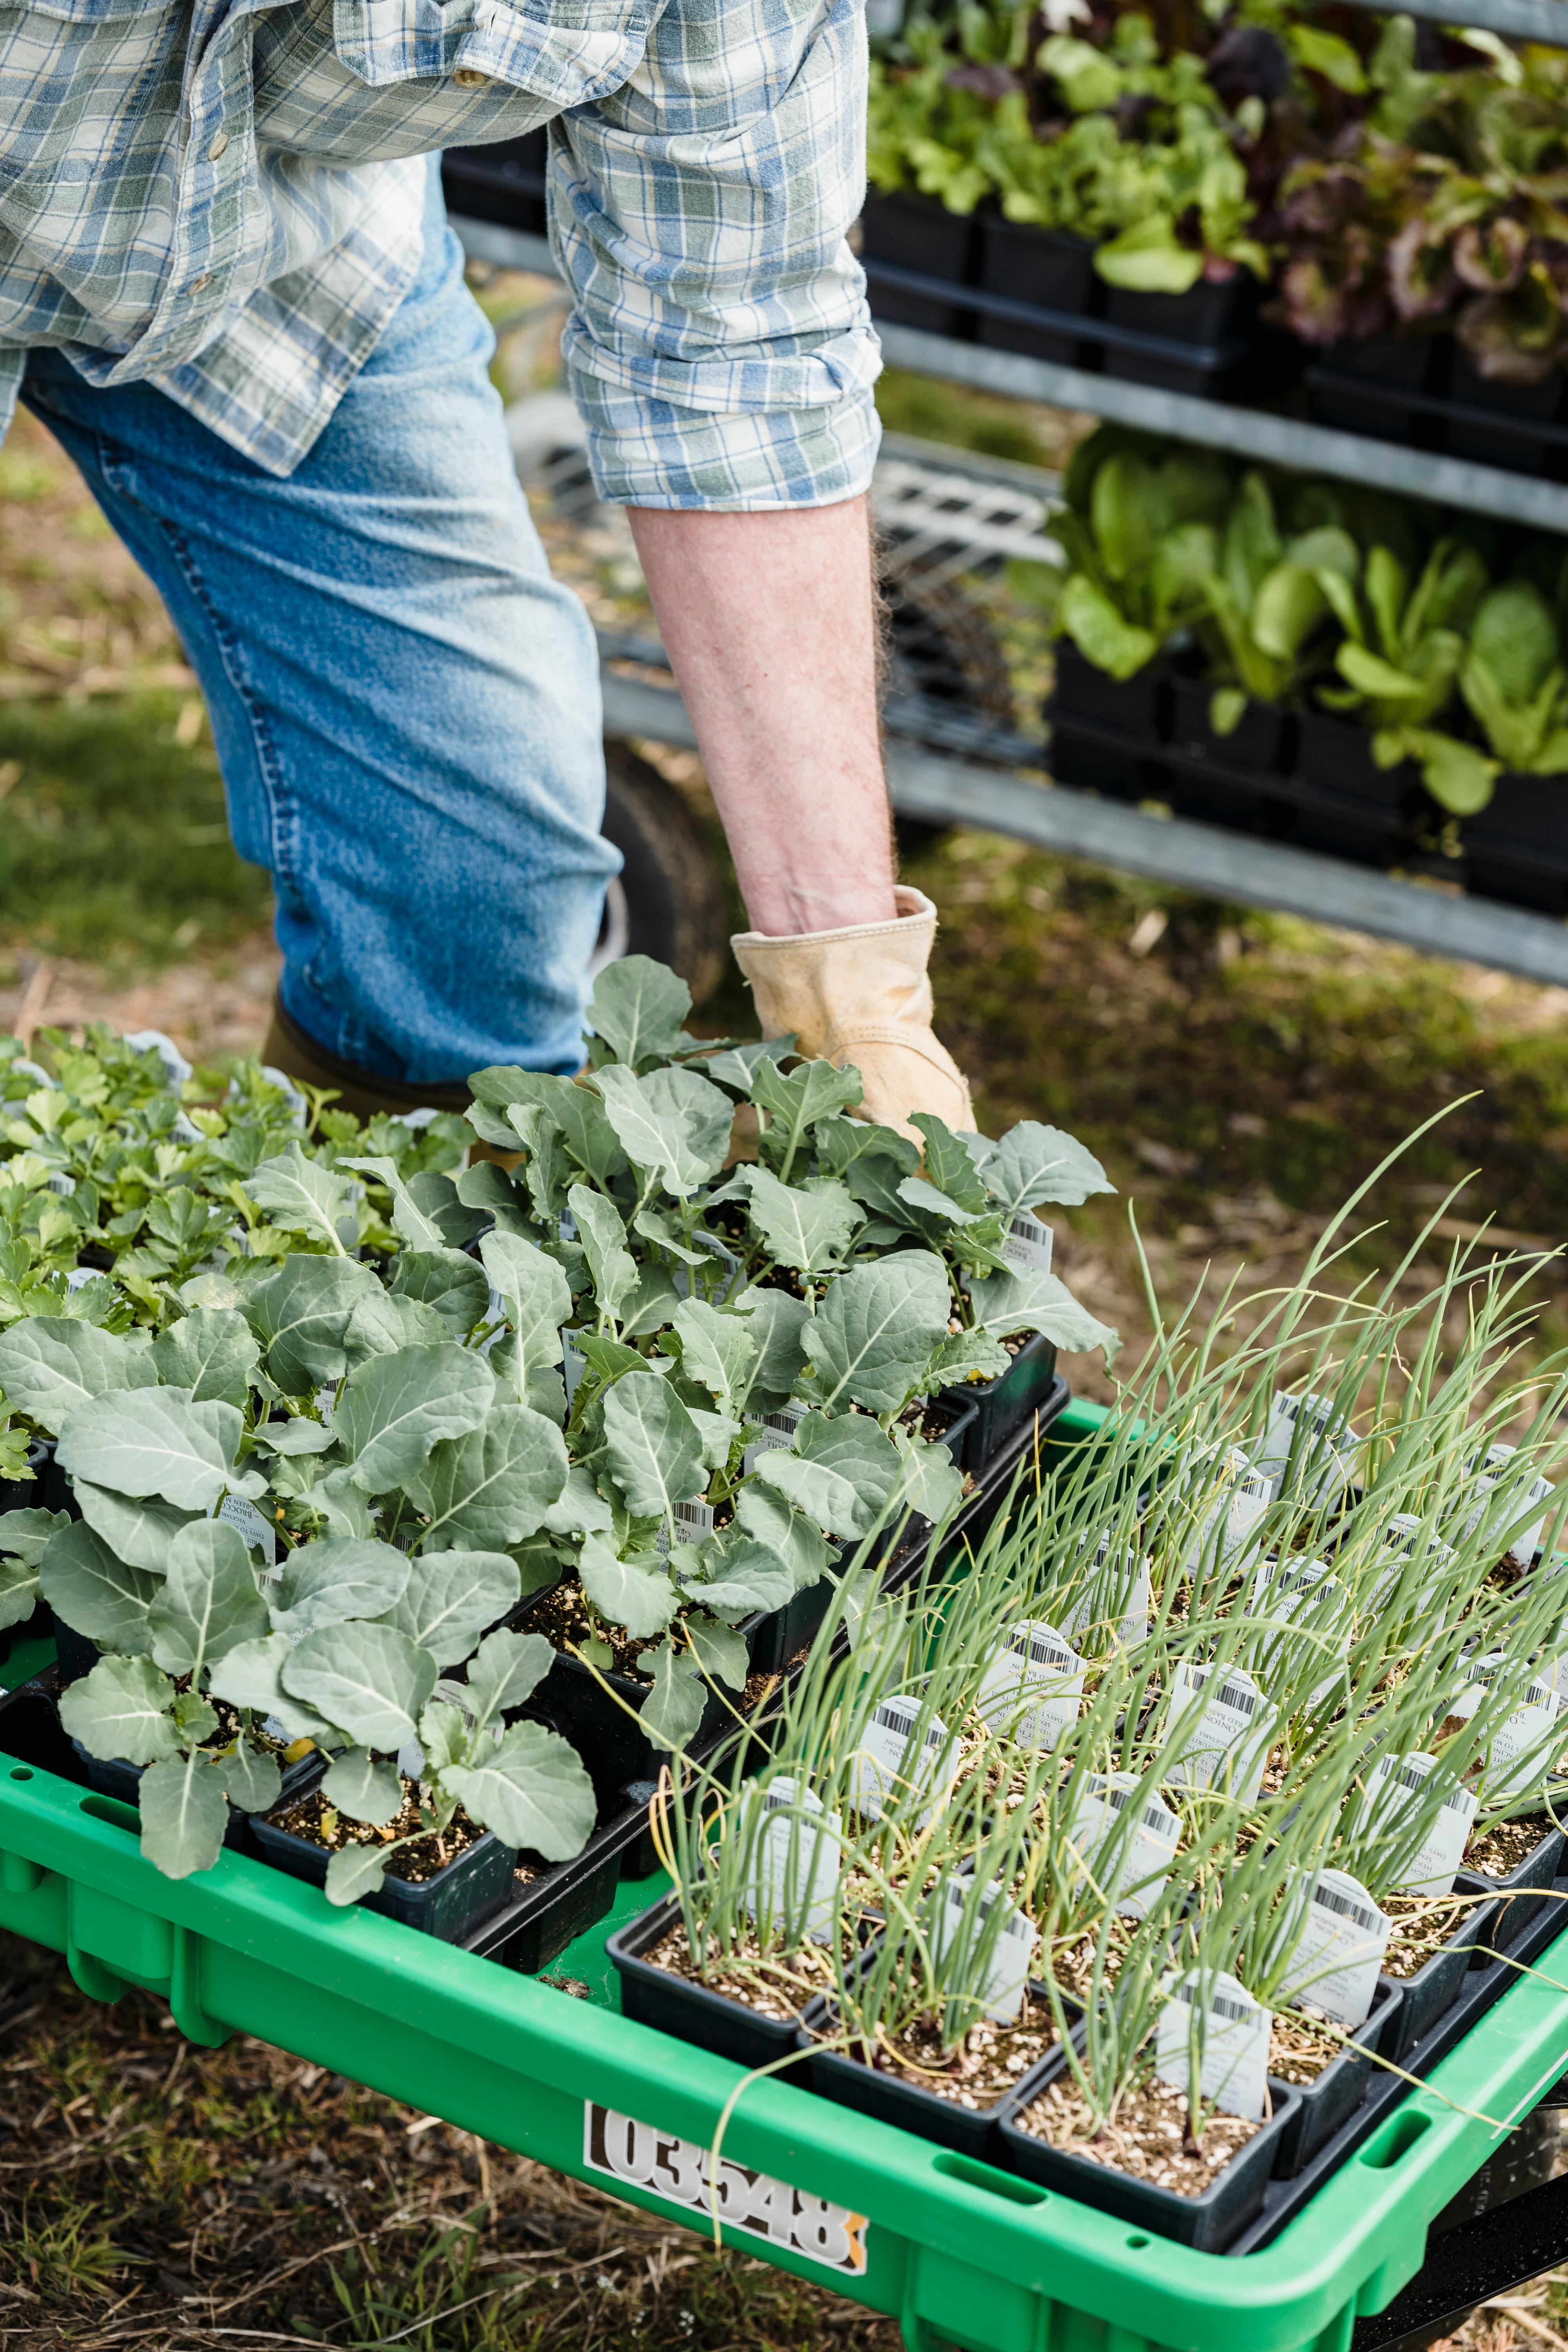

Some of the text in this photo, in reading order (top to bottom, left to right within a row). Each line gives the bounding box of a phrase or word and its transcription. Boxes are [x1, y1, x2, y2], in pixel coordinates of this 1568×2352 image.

[217, 1500, 253, 1519] BROCCO
[232, 1498, 257, 1512] 'GREEN
[249, 1530, 265, 1539] DAYS
[1019, 1624, 1061, 1643] www.wildercolocom
[1025, 1632, 1053, 1647] JSM066
[1009, 1662, 1037, 1678] BAON'
[1024, 1713, 1051, 1728] SPAIN
[1045, 1713, 1063, 1724] DAYS
[1203, 1706, 1226, 1720] BARO
[1201, 1713, 1237, 1734] ONION
[1198, 1730, 1228, 1748] EGETABLE
[1481, 1724, 1514, 1740] VEGEL
[883, 1738, 906, 1752] ARON'
[1190, 1736, 1221, 1754] MTURIT
[887, 1748, 922, 1768] OON
[1491, 1746, 1520, 1761] SACIN
[1195, 1765, 1210, 1775] FULL
[1209, 1762, 1238, 1779] HGT:
[867, 1795, 882, 1804] SUN
[1428, 1847, 1447, 1860] DAYS
[1409, 1867, 1428, 1879] LIGH
[604, 2109, 851, 2263] 03548
